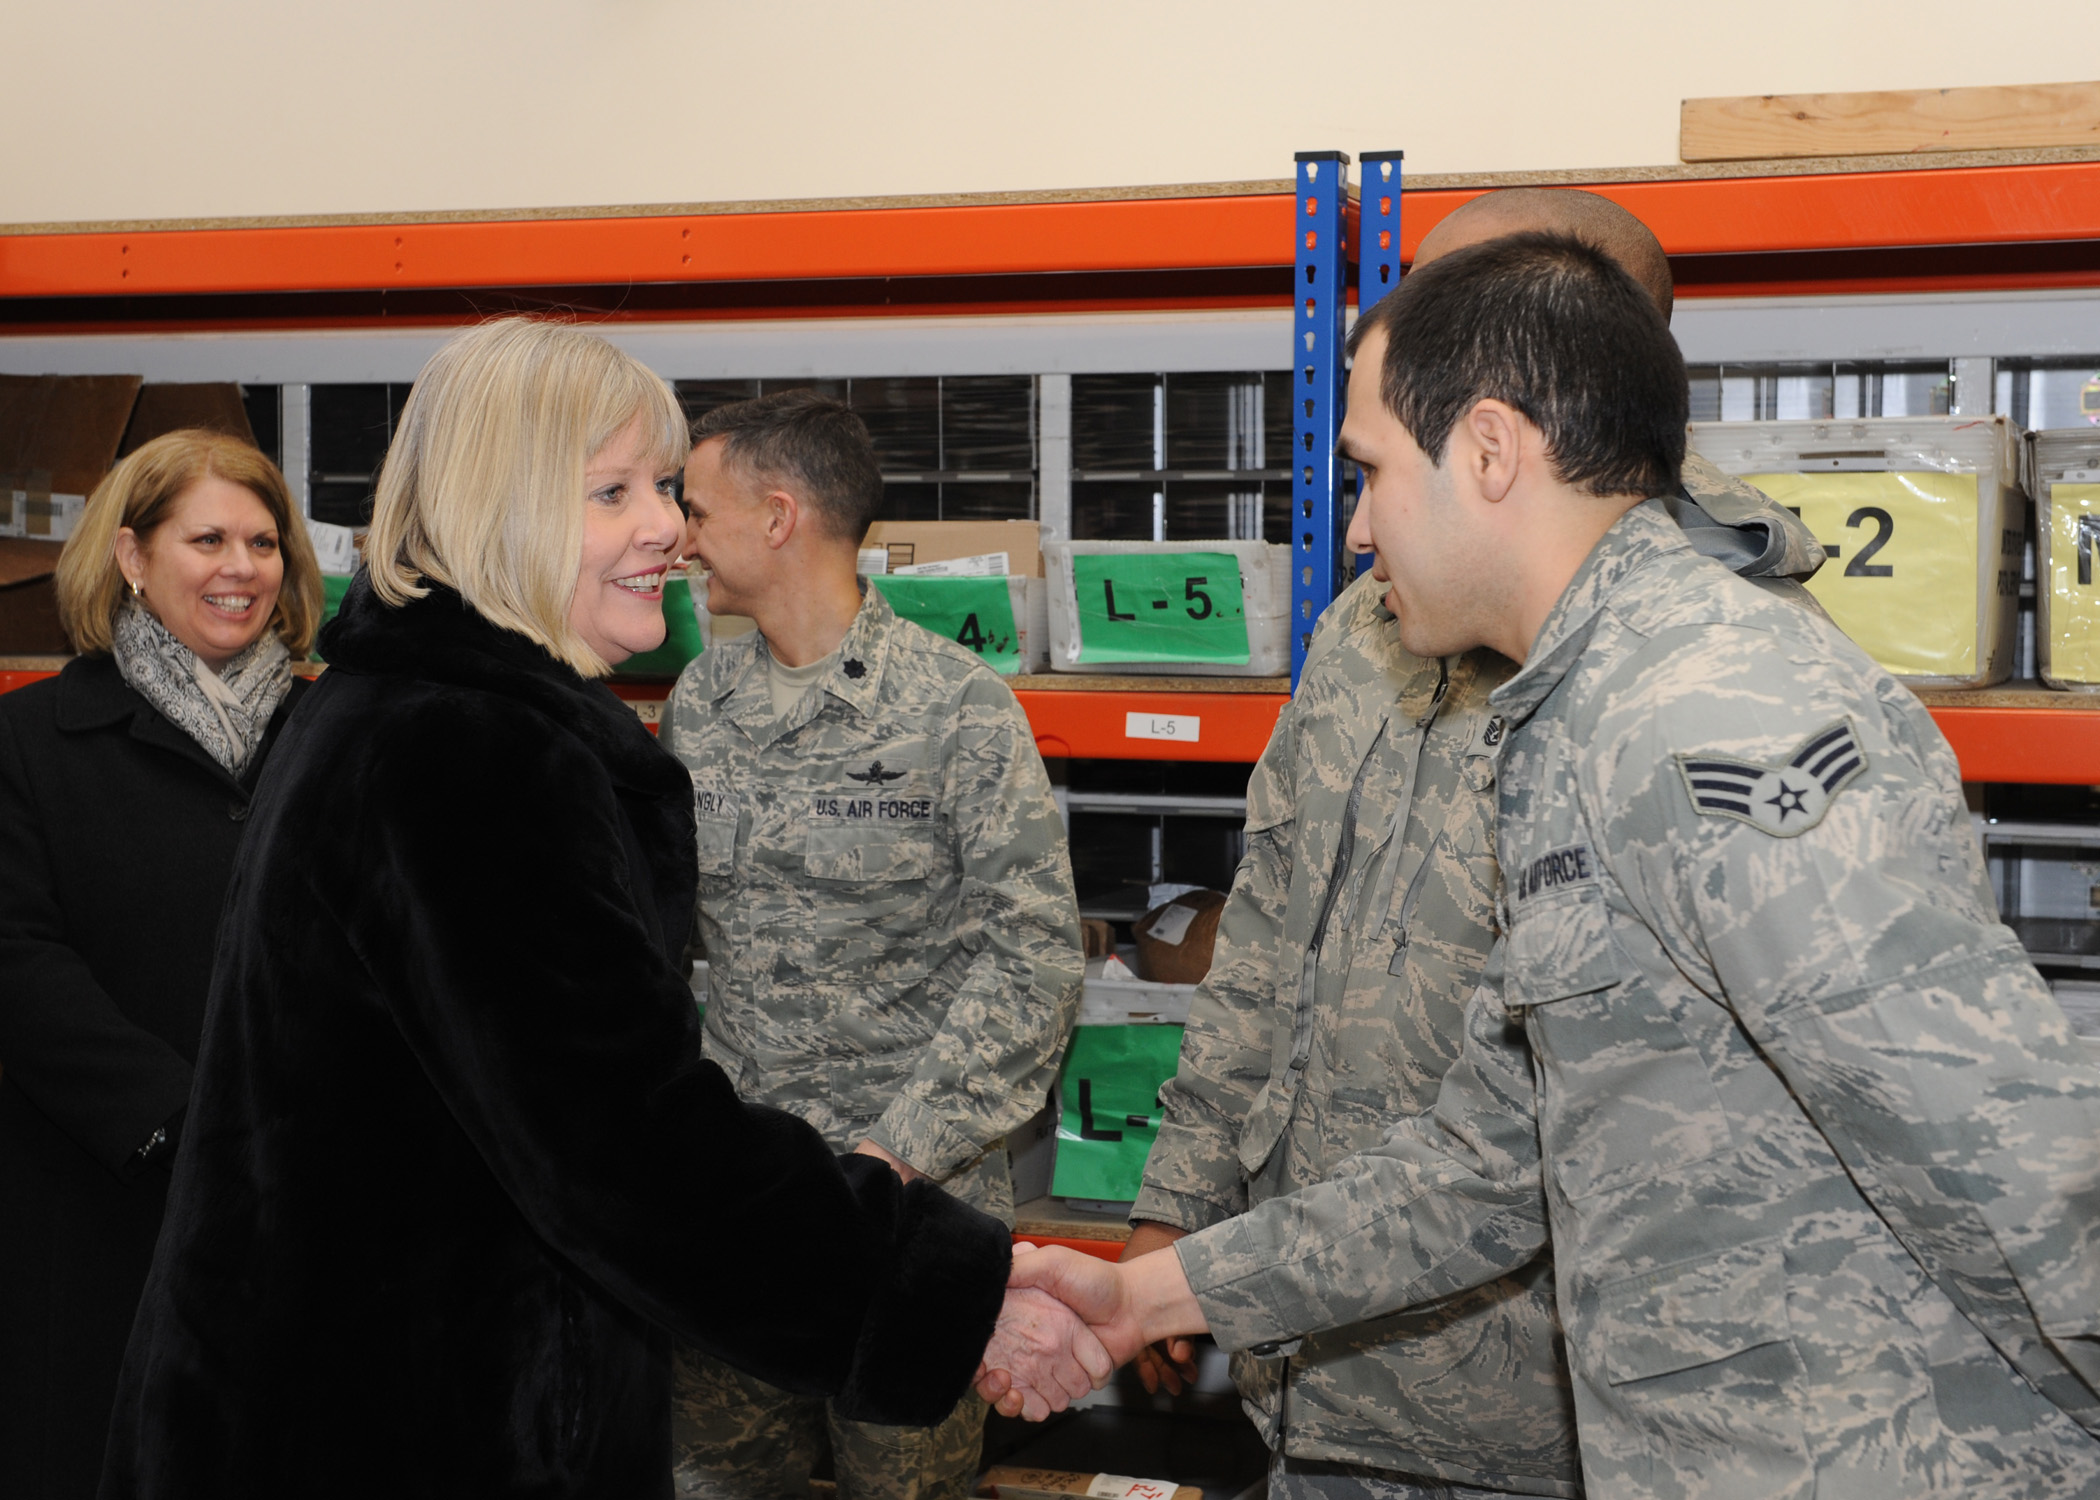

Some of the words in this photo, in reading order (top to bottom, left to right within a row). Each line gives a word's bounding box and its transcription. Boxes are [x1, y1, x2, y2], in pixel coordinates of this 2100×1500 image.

[956, 613, 987, 652] 4
[1150, 719, 1176, 735] L-5
[693, 790, 726, 813] NGLY
[816, 799, 841, 816] U.S.
[847, 800, 873, 818] AIR
[879, 801, 931, 819] FORCE
